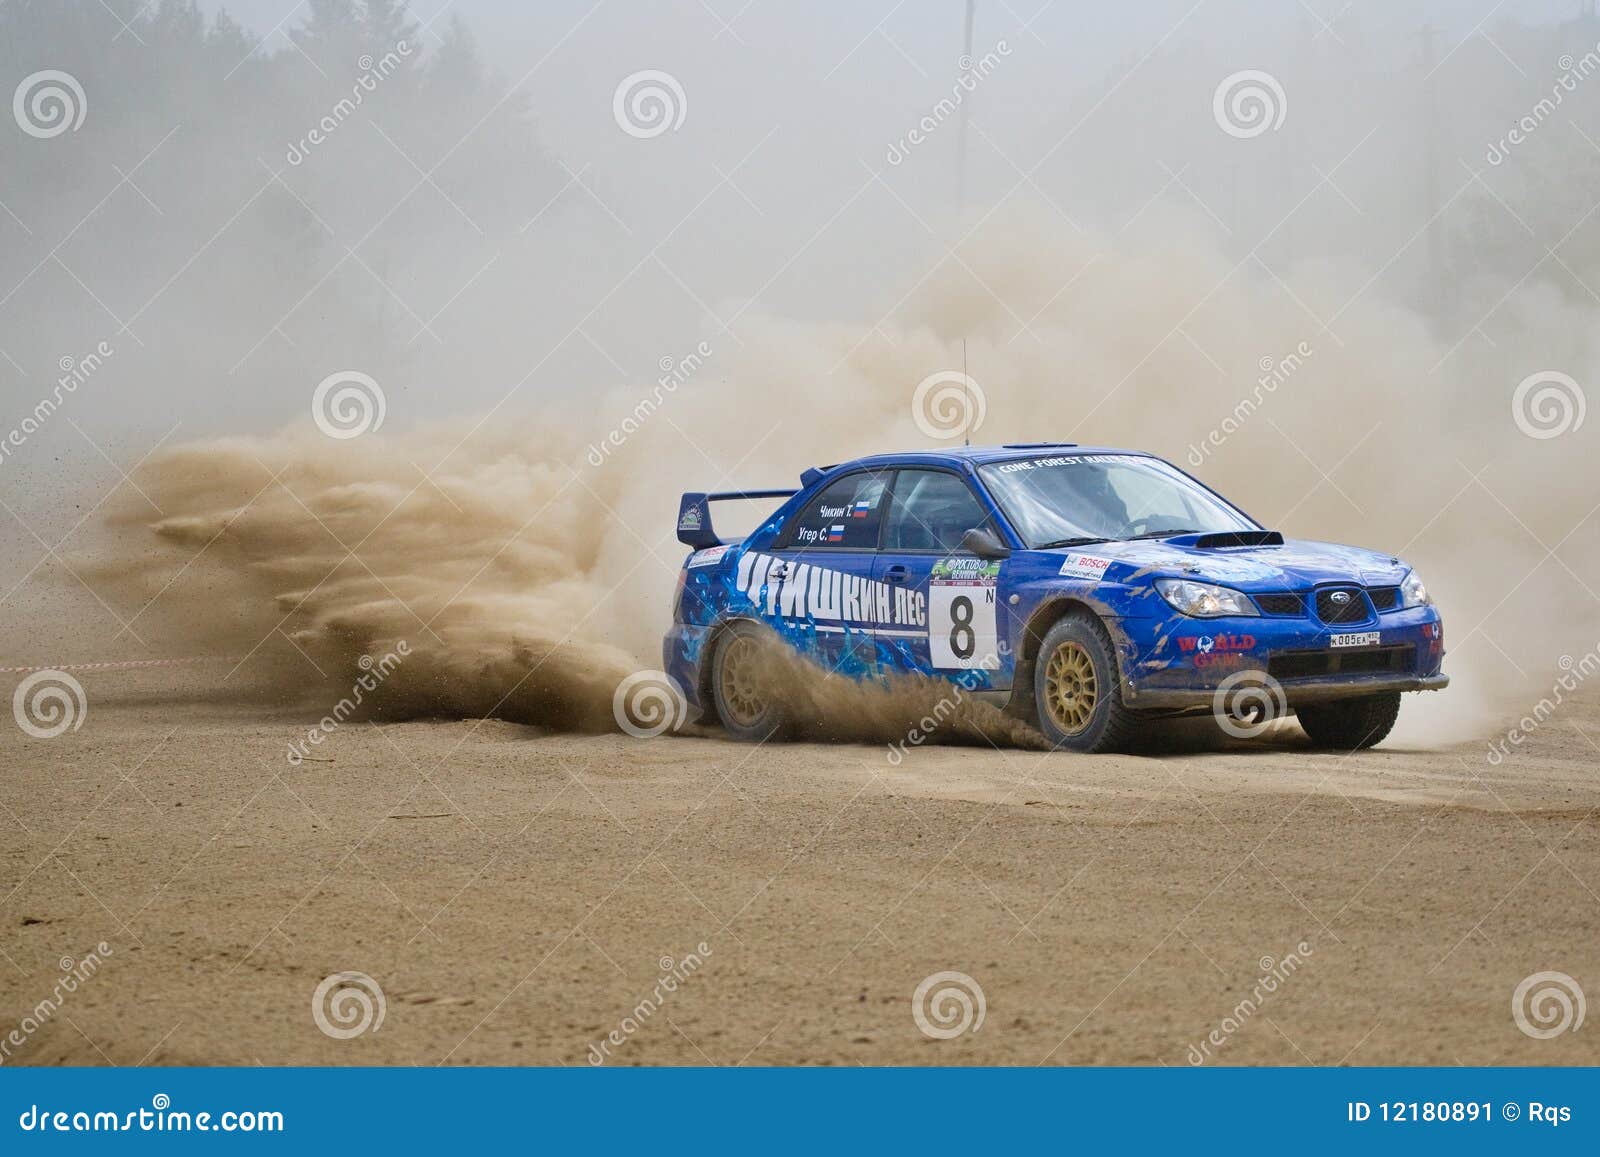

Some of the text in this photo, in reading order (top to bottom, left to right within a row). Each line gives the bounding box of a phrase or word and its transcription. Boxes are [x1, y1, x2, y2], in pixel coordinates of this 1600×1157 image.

[1034, 456, 1083, 468] FOREST
[820, 505, 845, 517] Чикин
[798, 527, 817, 543] Угер
[1080, 557, 1109, 569] BOSCH
[985, 588, 995, 604] N
[894, 585, 925, 627] ЛЕС
[949, 595, 976, 660] 8
